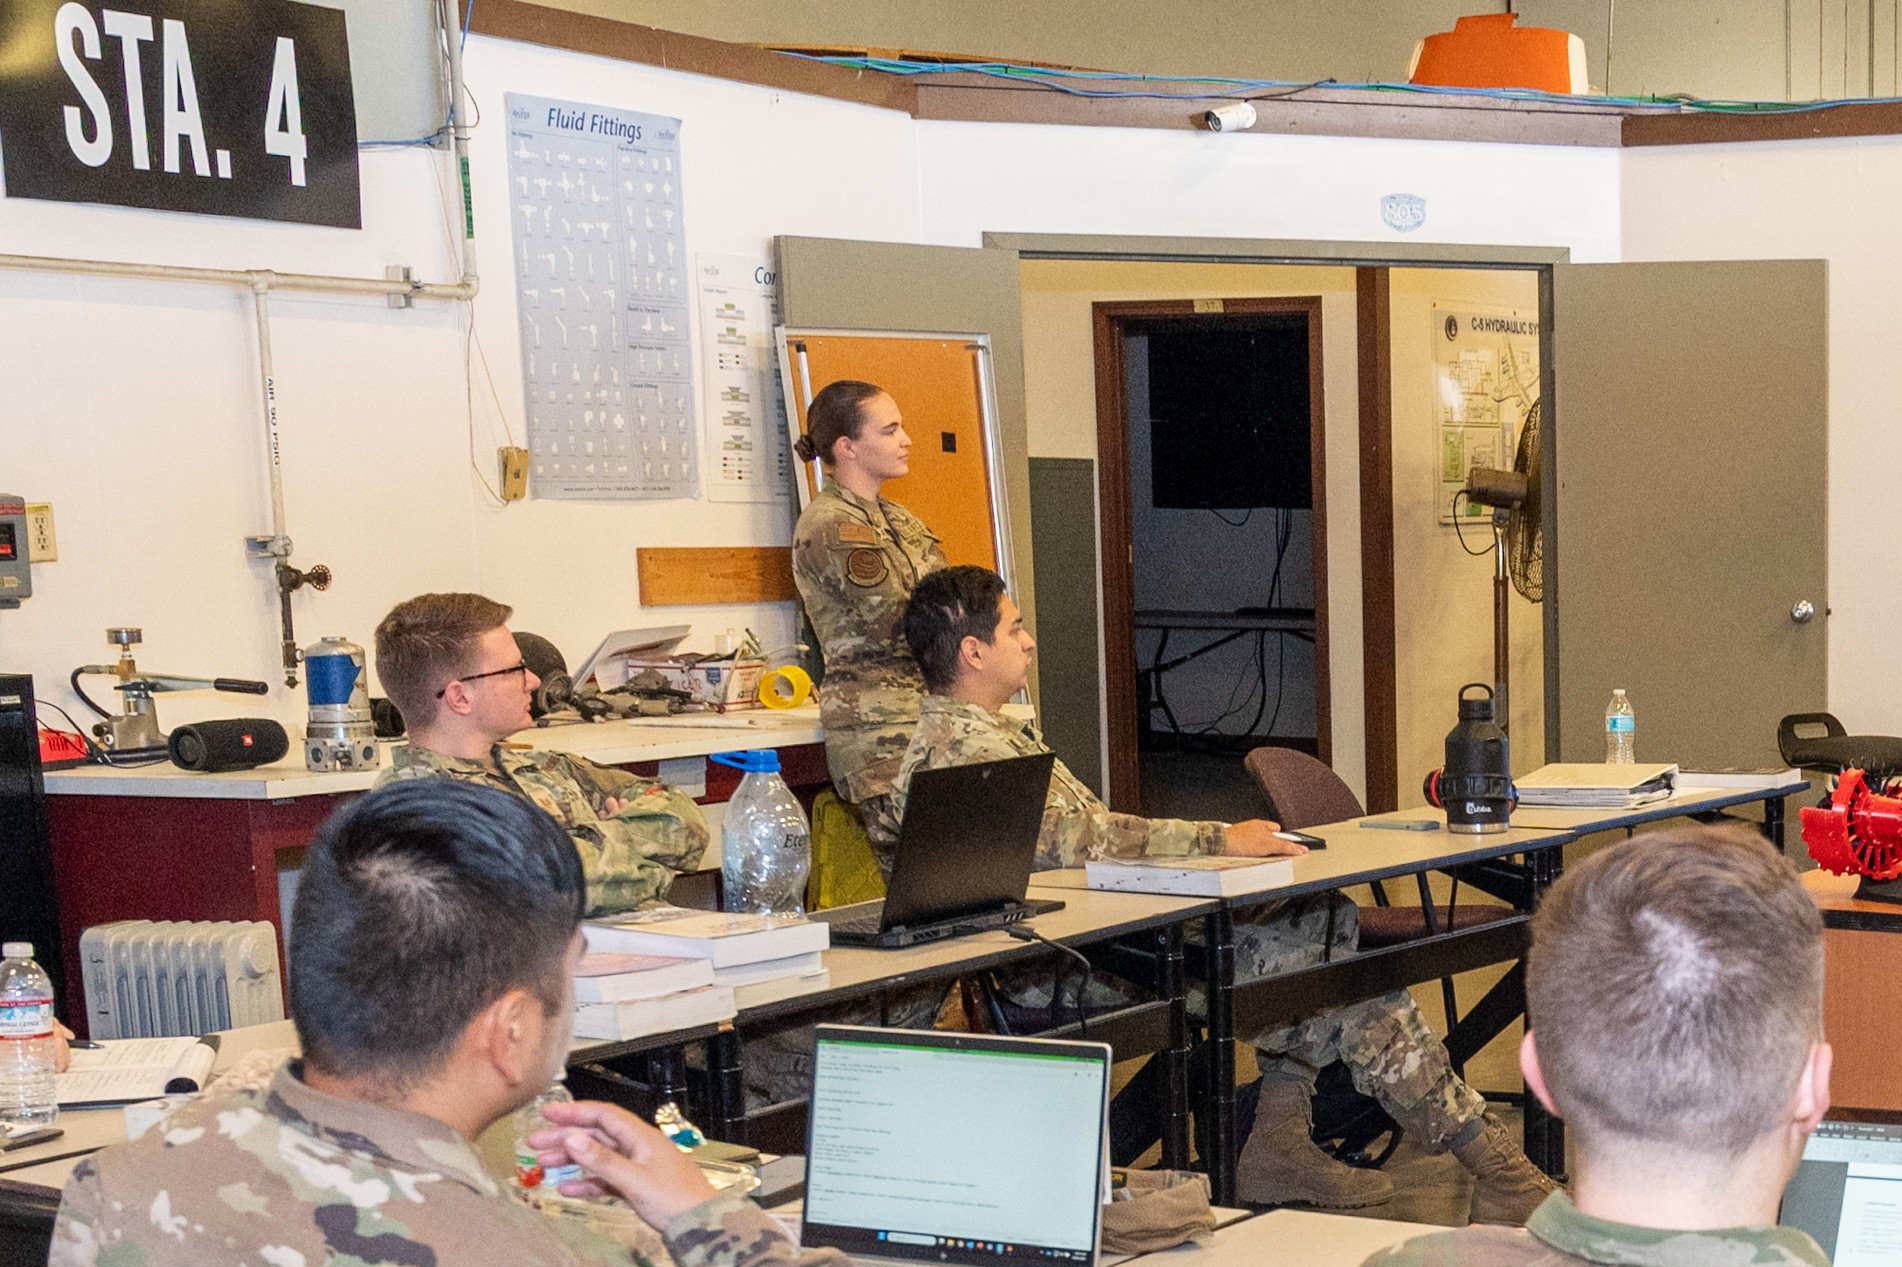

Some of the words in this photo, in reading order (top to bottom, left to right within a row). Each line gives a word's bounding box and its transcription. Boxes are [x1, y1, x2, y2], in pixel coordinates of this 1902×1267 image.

[55, 2, 232, 179] STA.
[264, 36, 308, 187] 4
[547, 107, 585, 131] Fluid
[590, 114, 642, 144] Fittings
[1471, 317, 1484, 331] C-5
[1485, 318, 1526, 335] HYDRAULIC
